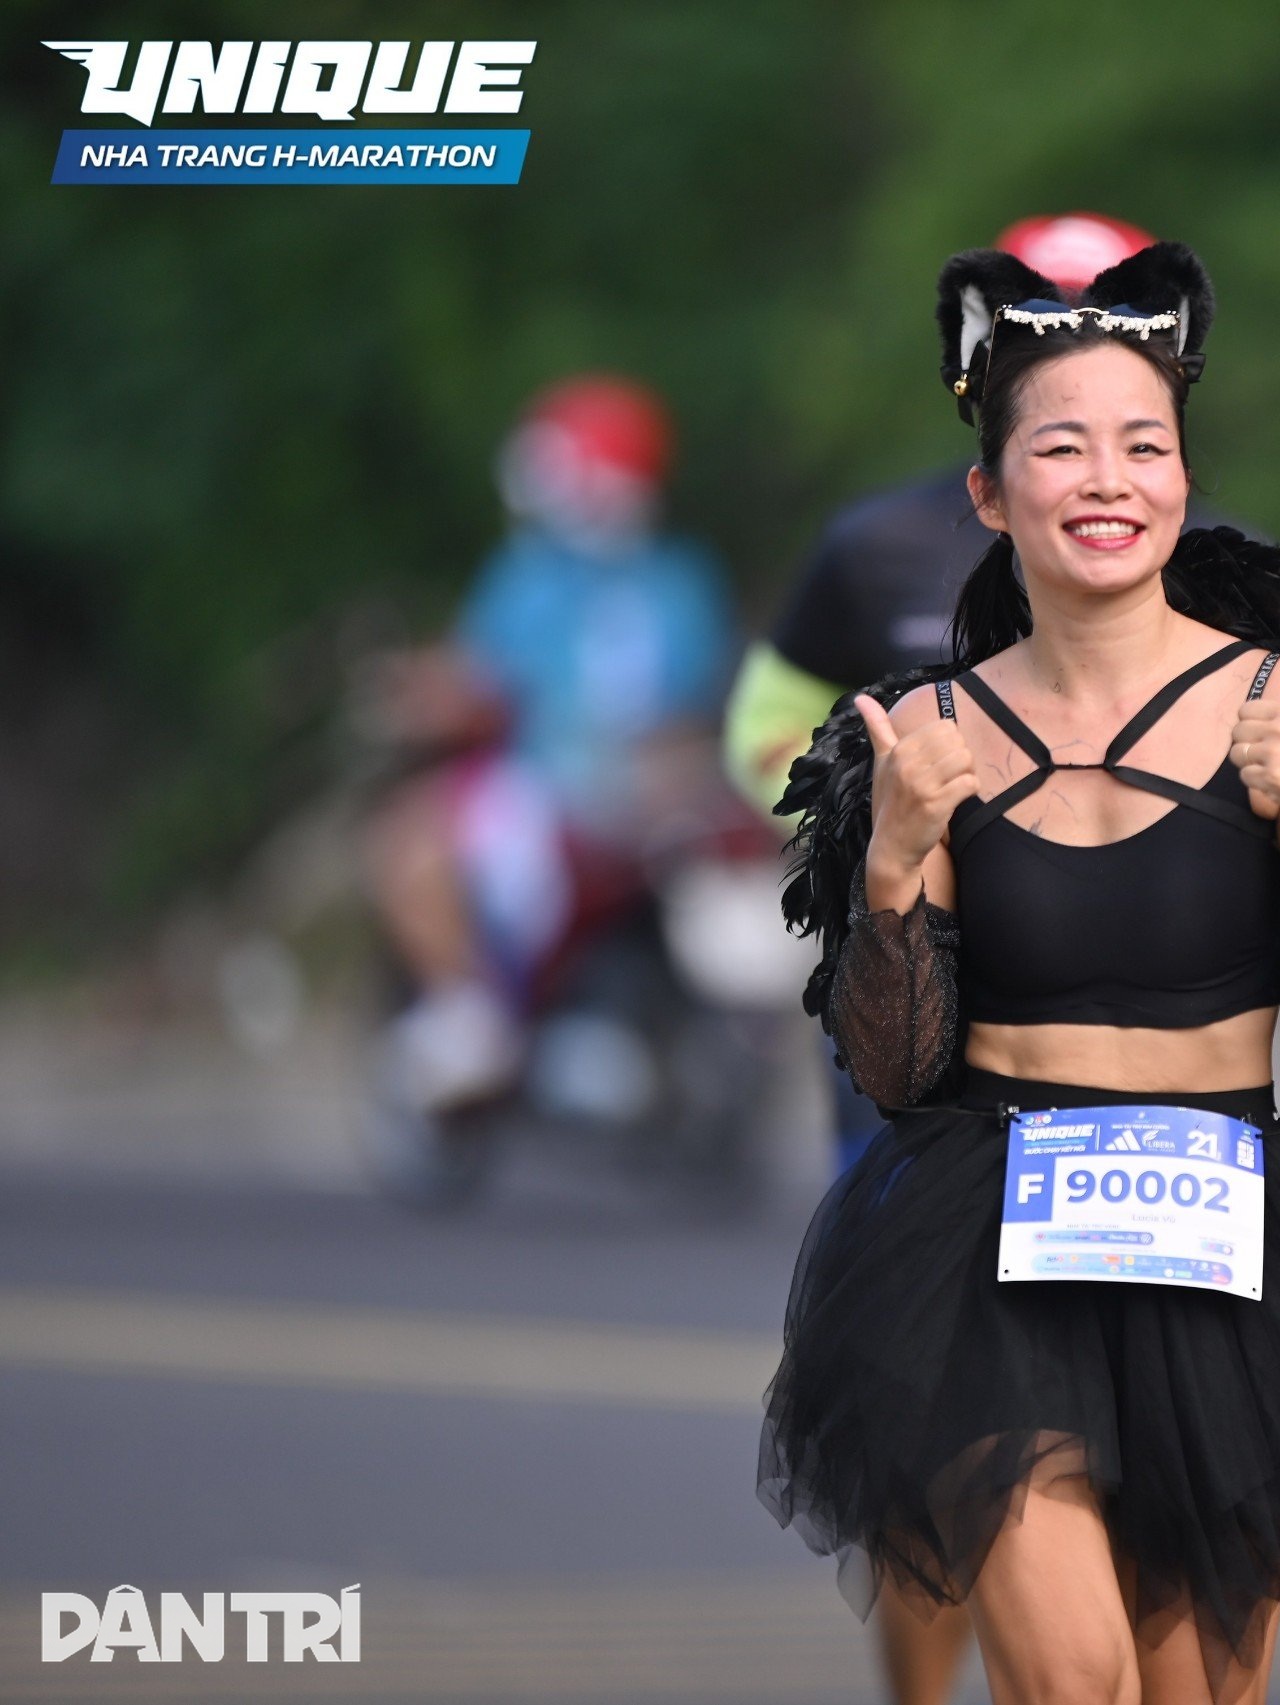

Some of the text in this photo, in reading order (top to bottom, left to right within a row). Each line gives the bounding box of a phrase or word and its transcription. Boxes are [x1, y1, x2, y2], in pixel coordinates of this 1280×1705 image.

[1018, 1124, 1096, 1141] UNIQUE
[1187, 1130, 1218, 1159] 21
[1017, 1173, 1045, 1204] F
[1066, 1169, 1230, 1213] 90002
